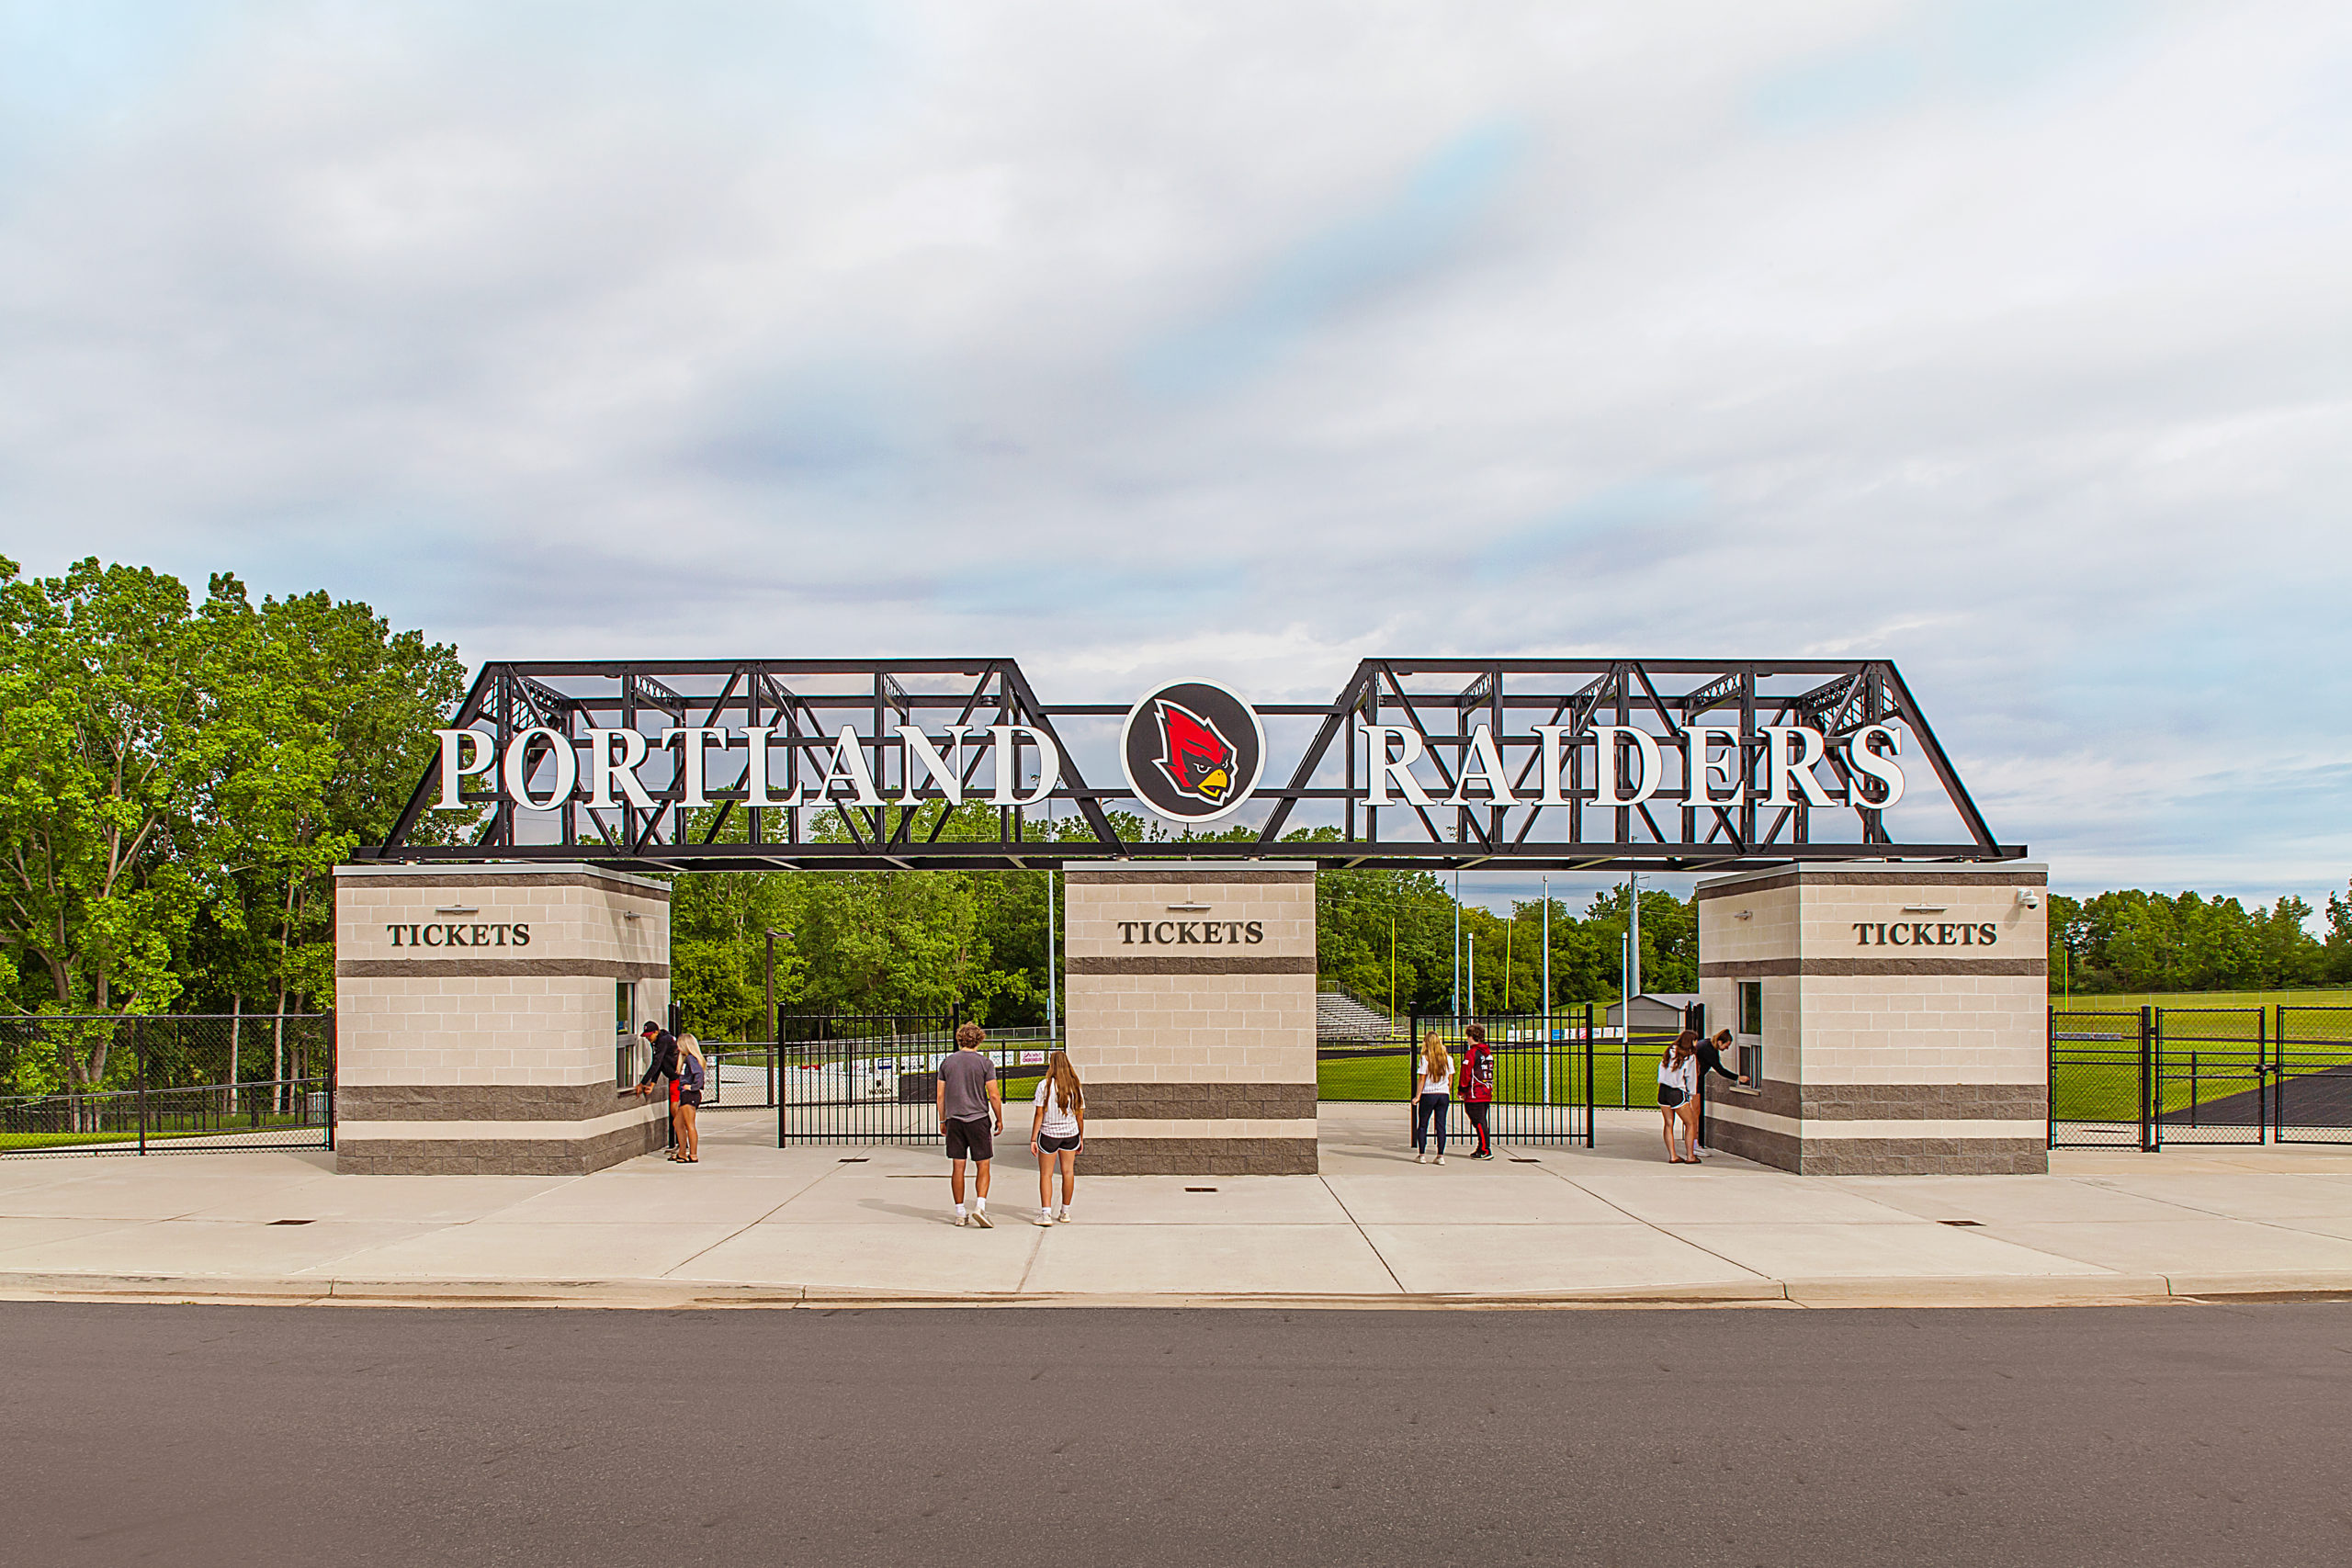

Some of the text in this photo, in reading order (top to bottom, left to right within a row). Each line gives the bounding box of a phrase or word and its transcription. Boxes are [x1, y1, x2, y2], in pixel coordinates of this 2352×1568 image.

[433, 725, 1905, 811] PORTLAND RAIDERS
[387, 924, 530, 946] TICKETS
[1118, 921, 1263, 944] TICKETS
[1853, 922, 1996, 945] TICKETS
